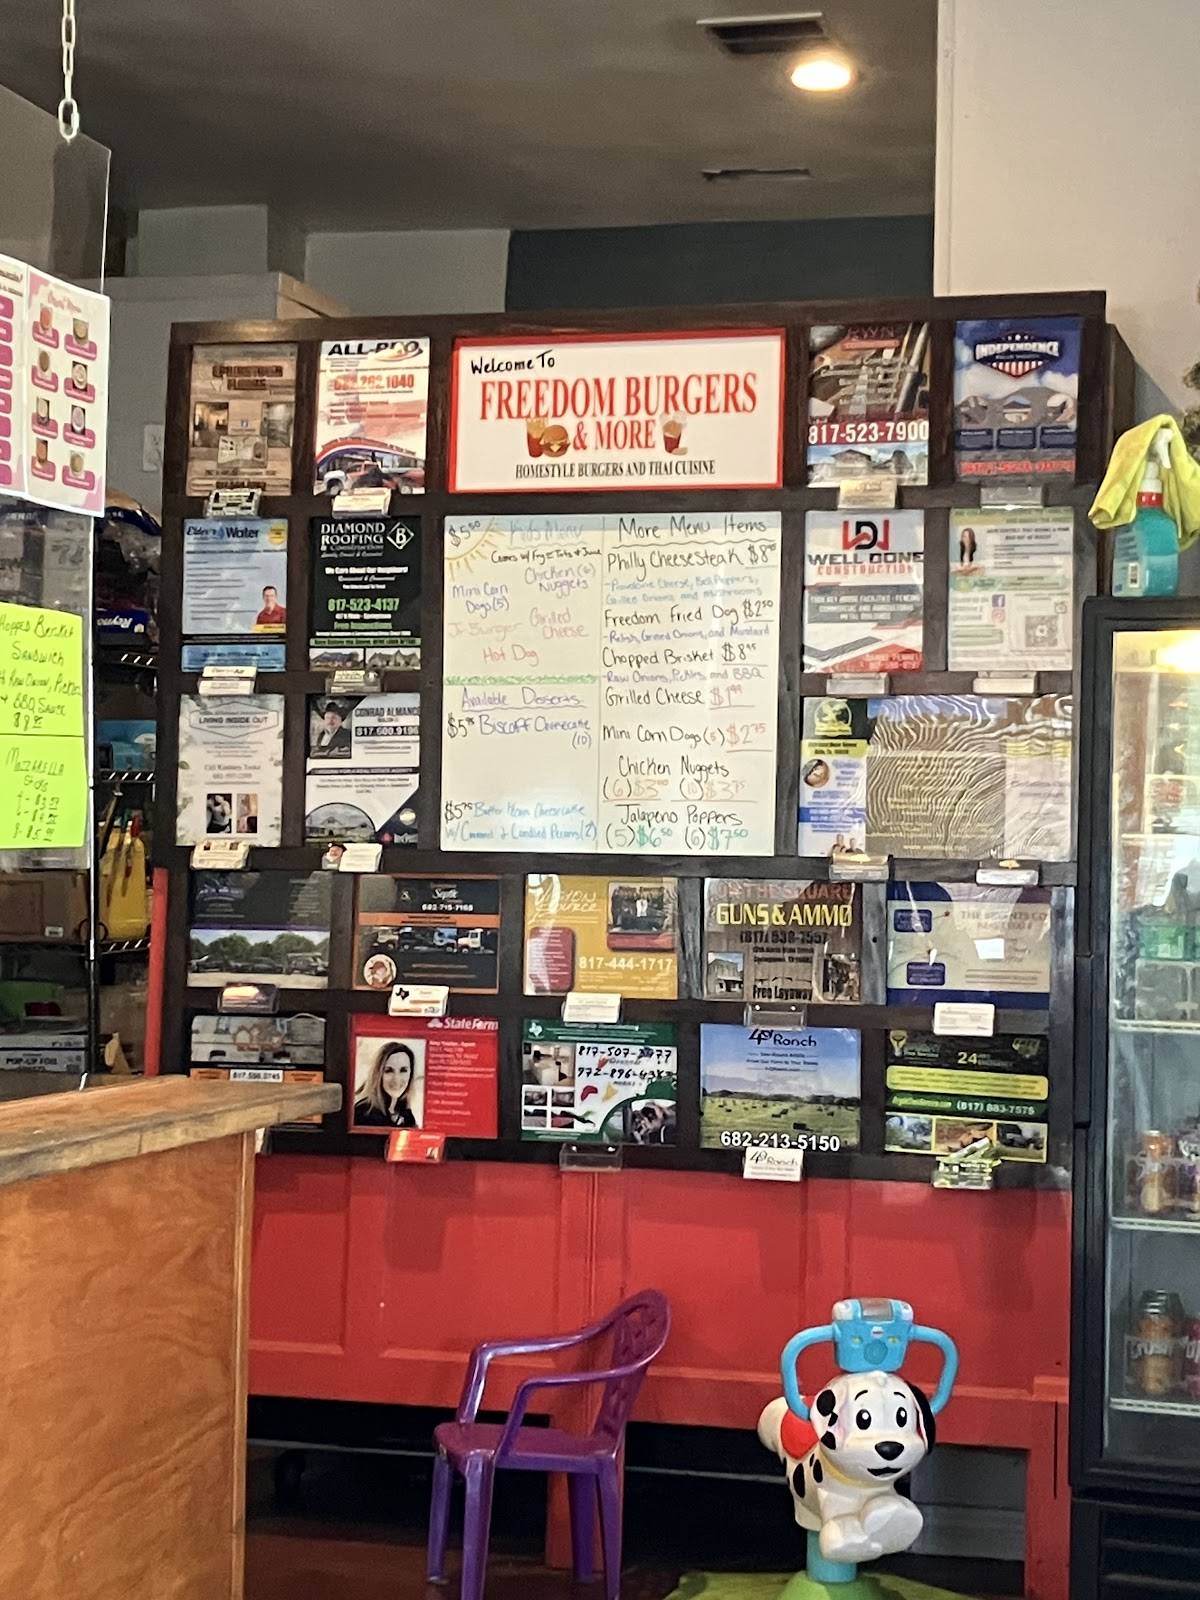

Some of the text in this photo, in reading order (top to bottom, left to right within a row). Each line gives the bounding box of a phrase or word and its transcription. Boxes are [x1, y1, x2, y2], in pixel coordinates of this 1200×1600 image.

[328, 340, 420, 356] ALL-PRO
[471, 350, 556, 374] Welcome To
[387, 373, 415, 388] 1040
[480, 372, 757, 420] FREEDOM BURGERS
[573, 419, 656, 450] & MORE
[808, 420, 930, 445] 817-523-7900
[515, 459, 716, 479] HOMESTYLE BURGERS AND THAI CUISINE
[226, 526, 260, 539] Water
[320, 522, 386, 534] DIAMOND
[618, 513, 768, 542] More Menu Items
[320, 533, 384, 545] ROOFING
[607, 552, 647, 582] Philly
[808, 551, 924, 565] WELL DONE
[524, 565, 575, 585] Chicken
[817, 564, 913, 576] CONSTRUCTION
[452, 584, 481, 599] Mini
[539, 579, 589, 600] Nuggets
[604, 608, 661, 628] Freedom
[670, 603, 703, 623] Fried
[711, 604, 739, 626] Dog
[483, 643, 540, 668] Hot Dog
[602, 646, 659, 670] Chopped
[664, 648, 715, 666] Brisket
[732, 667, 766, 681] BBQ
[605, 685, 651, 707] Grilled
[655, 687, 706, 705] Cheese
[602, 724, 631, 742] Mini
[637, 724, 668, 743] Corn
[618, 754, 730, 783] Chicken Nuggets
[615, 803, 744, 828] Jalapeno Poppers
[605, 823, 636, 849] (5)
[684, 826, 706, 850] (6)
[716, 902, 853, 927] GUNS & AMMO
[578, 956, 673, 971] 817-444-1717
[752, 984, 773, 1000] Free
[444, 1017, 499, 1031] State Farm
[773, 1033, 818, 1047] Ranch
[957, 1051, 978, 1065] 24
[720, 1130, 841, 1152] 682-213-5150
